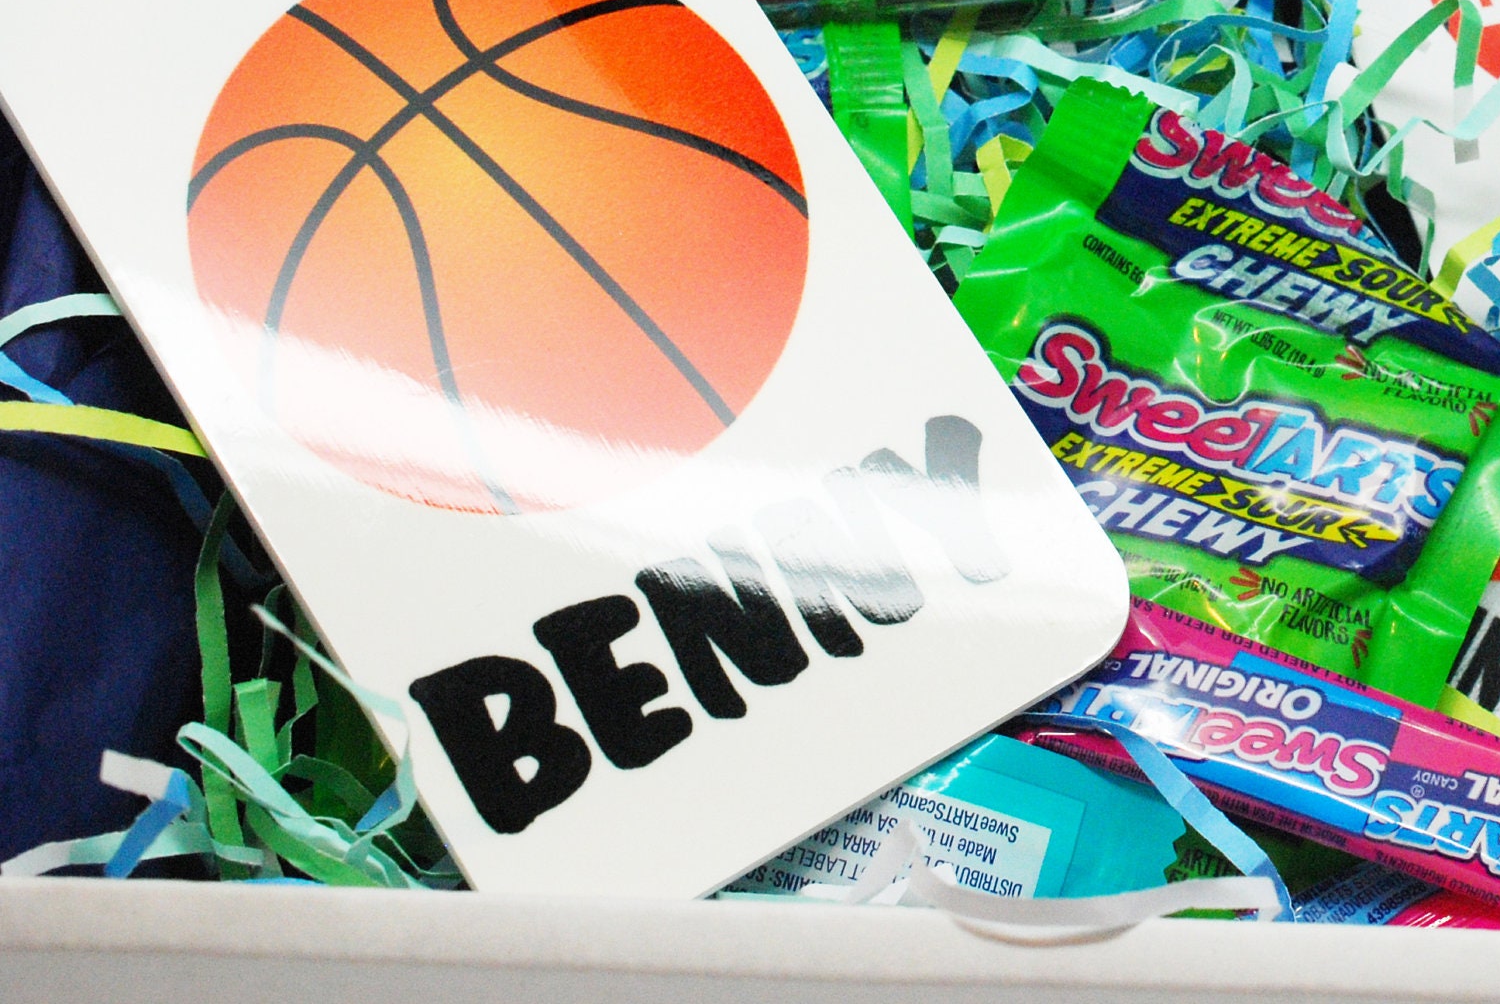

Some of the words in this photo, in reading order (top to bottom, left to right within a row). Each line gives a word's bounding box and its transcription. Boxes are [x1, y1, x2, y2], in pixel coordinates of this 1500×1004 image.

[1082, 234, 1132, 278] CONTAINS
[1168, 197, 1328, 268] EXTREME
[1334, 258, 1444, 314] SOUR
[1174, 245, 1419, 345] CHEWY
[1017, 330, 1465, 522] SweeTARTS
[1050, 432, 1207, 496] EXTREME
[1221, 484, 1335, 539] SOUR
[1075, 479, 1312, 563] CHEWY
[409, 415, 1010, 834] BENNY
[1261, 576, 1289, 599] NO
[1291, 588, 1373, 631] ARTIFICIAL
[1279, 604, 1350, 646] FLAVORS
[1127, 652, 1323, 720] ORIGINAL
[1412, 769, 1459, 791] CANDY
[938, 833, 956, 847] in
[958, 840, 997, 866] Made
